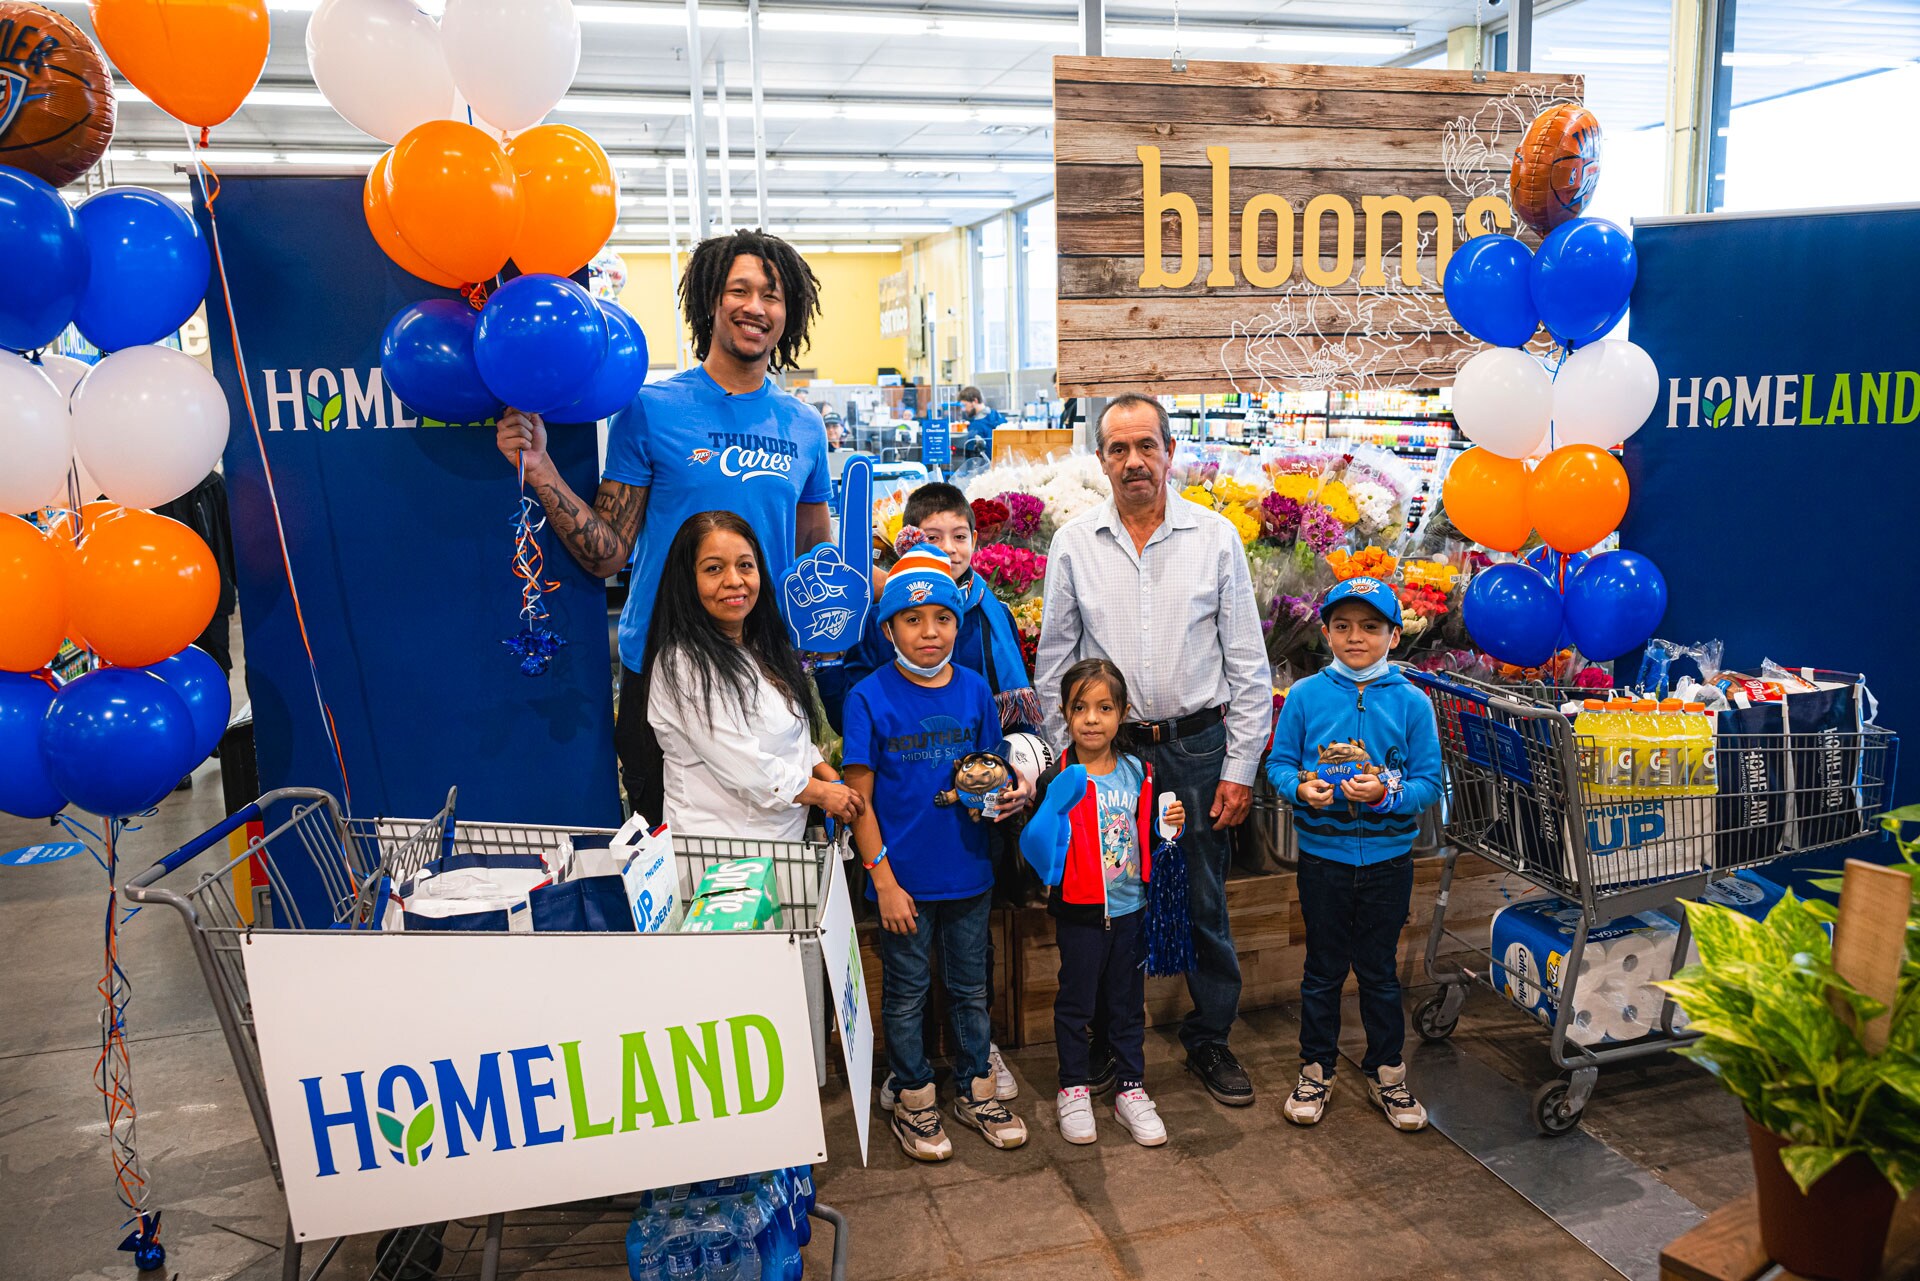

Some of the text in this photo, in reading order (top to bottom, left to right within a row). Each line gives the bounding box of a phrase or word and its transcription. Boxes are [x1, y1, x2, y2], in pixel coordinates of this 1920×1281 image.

[1666, 370, 1920, 429] HOMELAND
[708, 432, 799, 459] THUNDER
[720, 445, 792, 477] Cares
[1347, 577, 1380, 590] THUNDER
[902, 749, 942, 762] MIDDLE
[1586, 801, 1664, 819] THUNDER
[1584, 814, 1665, 857] UP
[703, 861, 764, 915] Sprite
[633, 889, 654, 933] UP
[300, 1013, 786, 1178] HOMELAND
